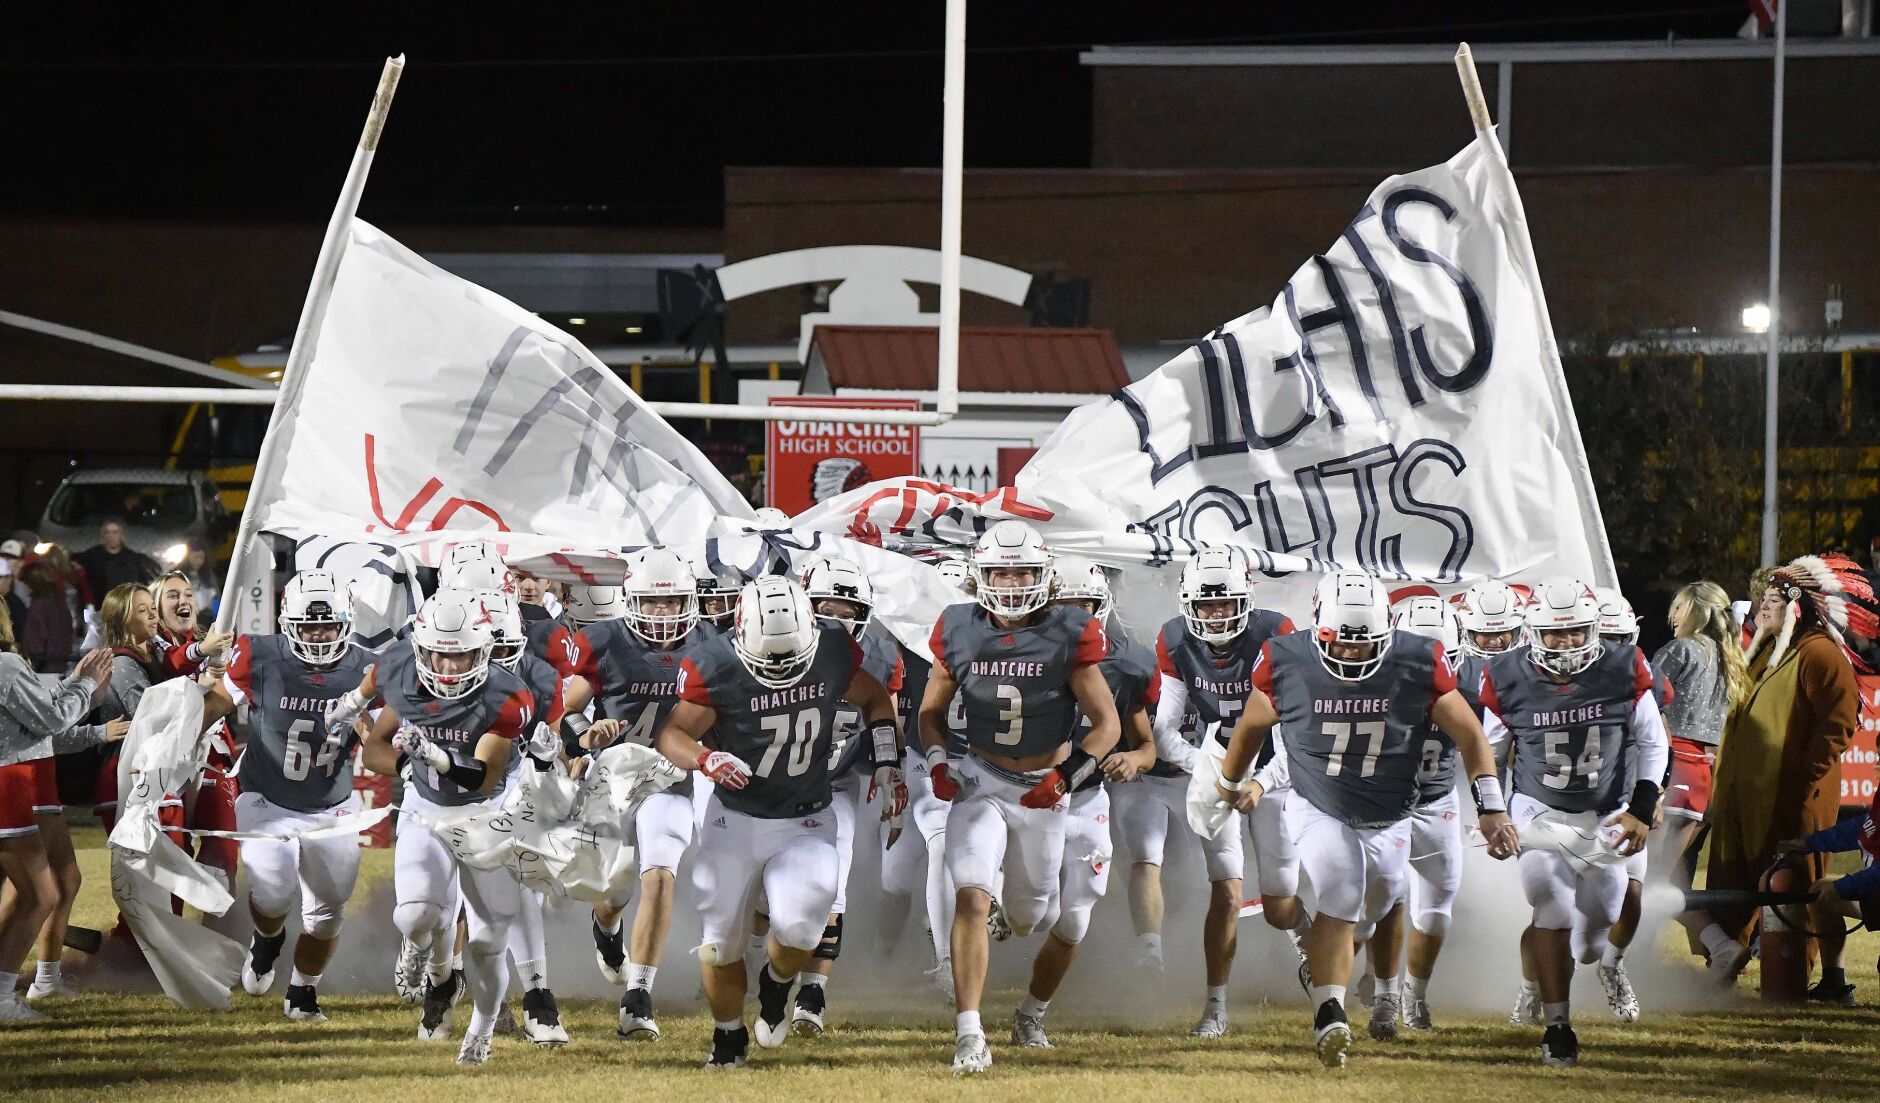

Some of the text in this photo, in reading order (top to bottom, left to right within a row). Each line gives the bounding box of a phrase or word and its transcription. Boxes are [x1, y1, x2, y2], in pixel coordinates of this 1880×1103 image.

[780, 438, 912, 456] HIGH SCHOOL
[971, 661, 1043, 677] OHATCHEE
[631, 682, 676, 696] OHATC
[1195, 676, 1250, 695] OHATCHE
[280, 696, 327, 713] OHATC
[751, 682, 825, 712] OHATCHEE
[1314, 698, 1389, 714] OHATCHEE
[994, 684, 1023, 746] 3
[1533, 704, 1603, 727] OHATCHEE
[422, 726, 470, 743] ATCHEE
[755, 707, 821, 779] 70
[283, 718, 341, 782] 64
[1321, 721, 1386, 778] 77
[1542, 725, 1604, 790] 54
